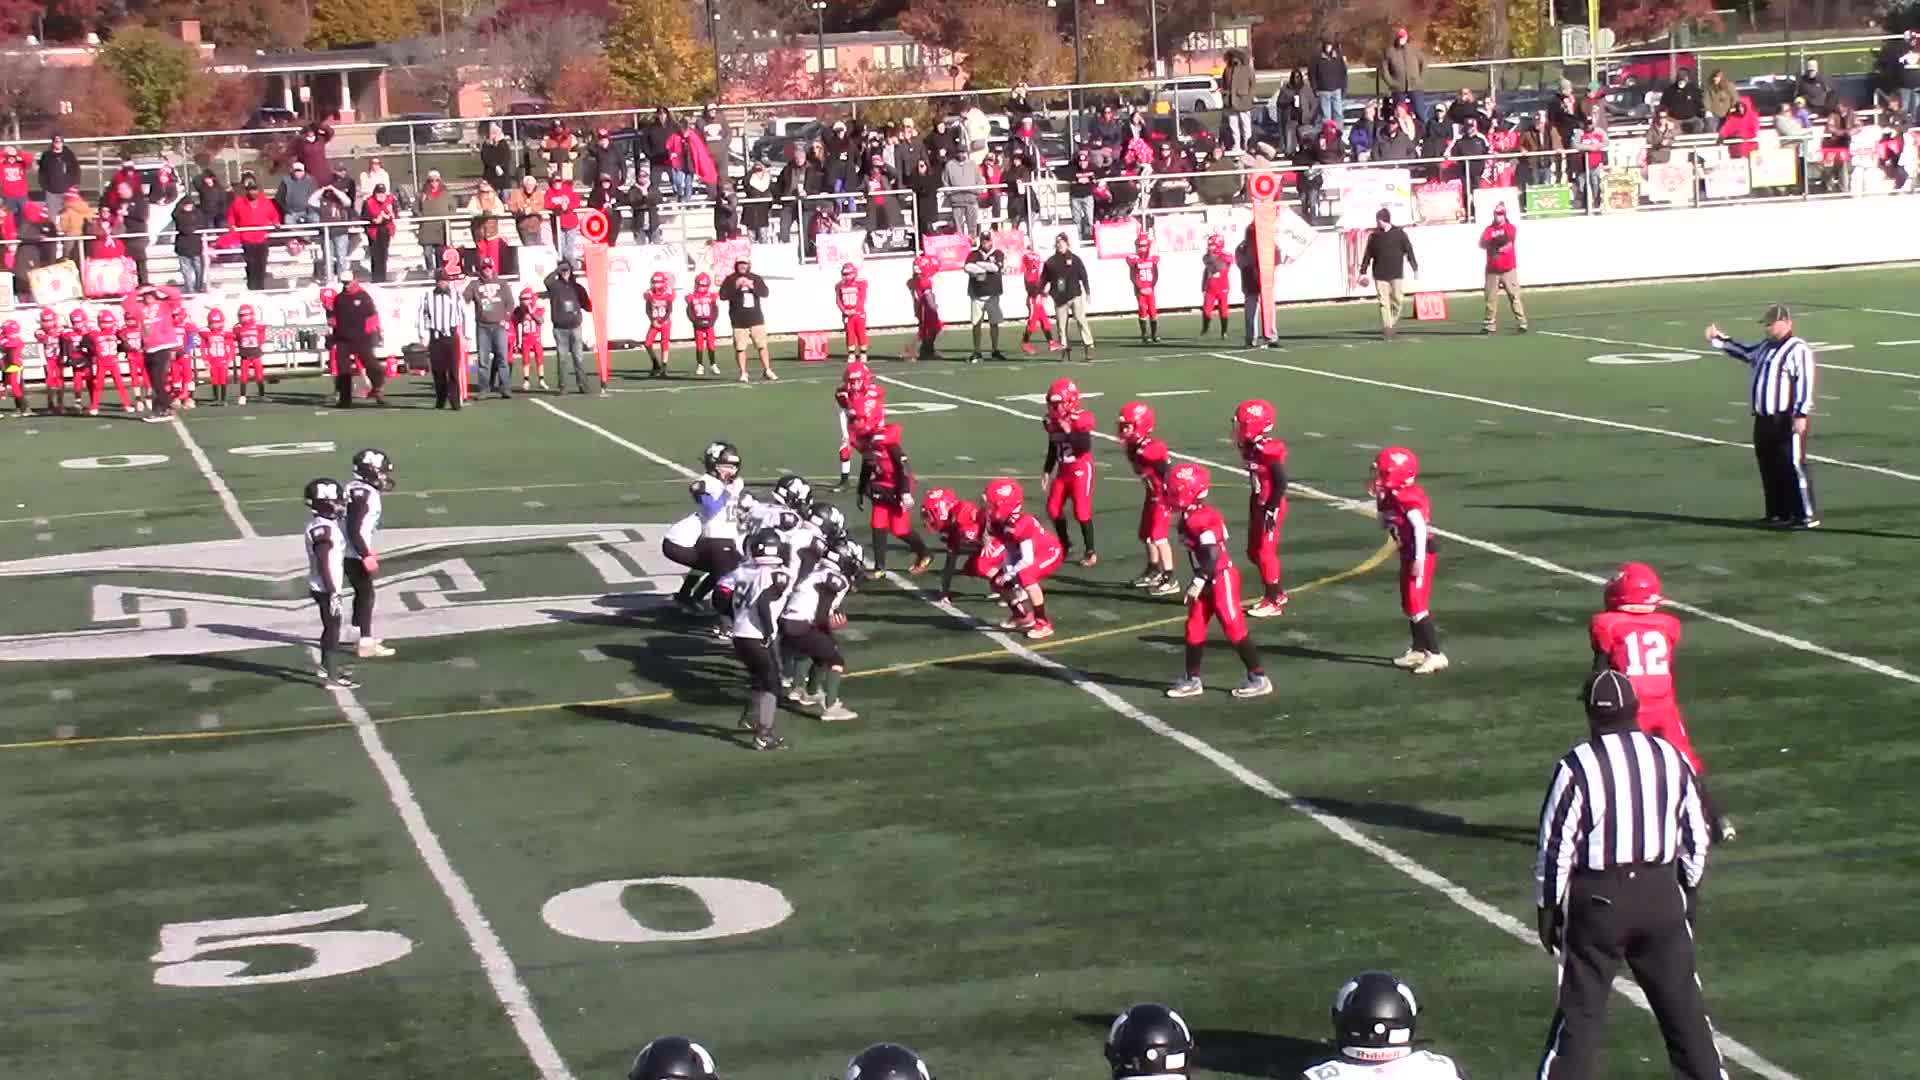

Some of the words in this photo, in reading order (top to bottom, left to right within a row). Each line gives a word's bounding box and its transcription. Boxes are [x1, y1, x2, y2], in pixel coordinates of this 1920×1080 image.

[442, 248, 463, 275] 2
[317, 483, 338, 499] M
[1625, 630, 1670, 675] 12
[149, 876, 795, 988] 50
